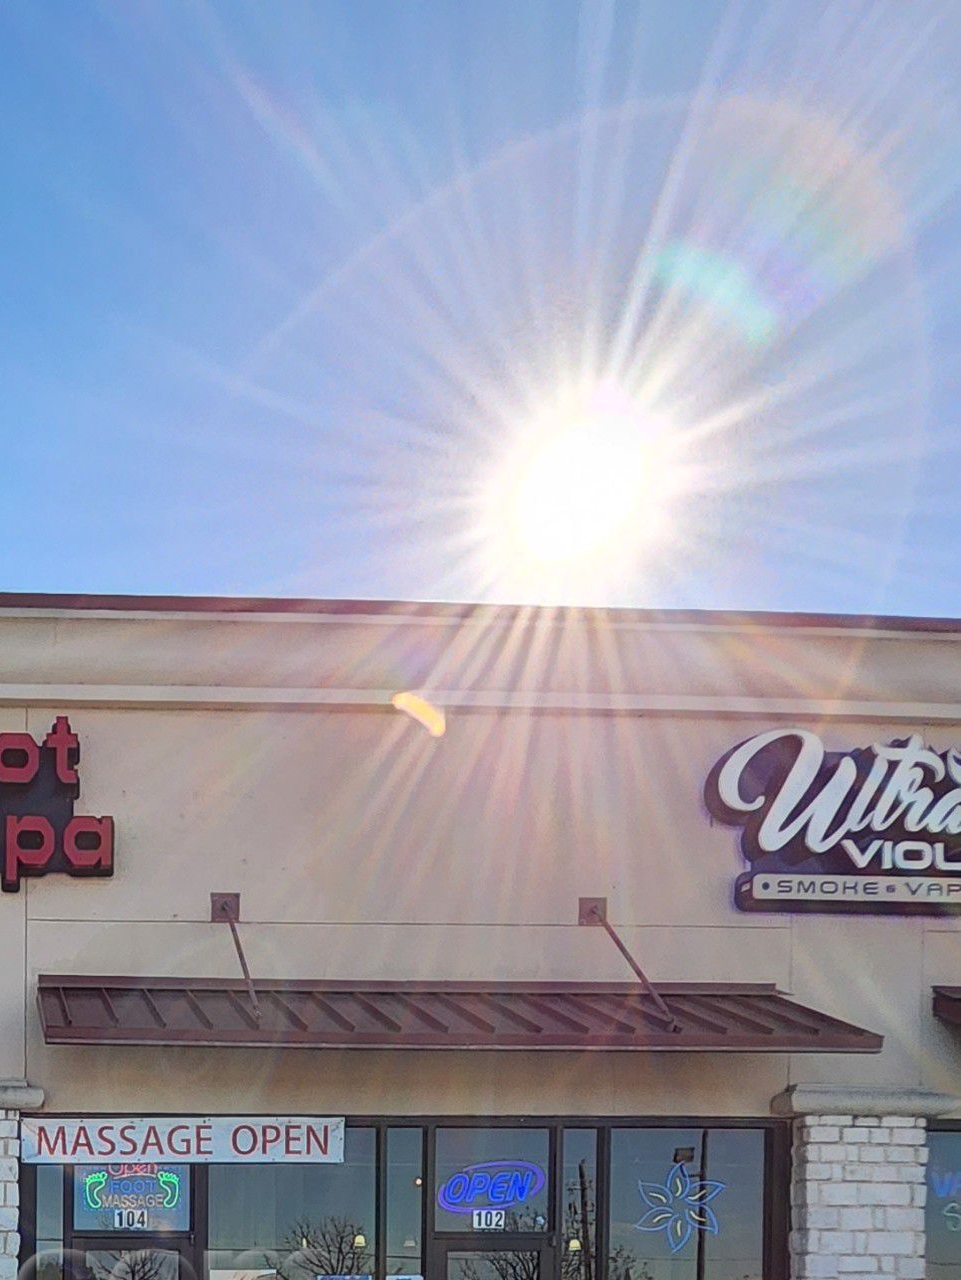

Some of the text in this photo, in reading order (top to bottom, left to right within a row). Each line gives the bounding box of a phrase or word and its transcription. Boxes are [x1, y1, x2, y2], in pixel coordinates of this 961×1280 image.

[777, 880, 879, 895] SMOKE
[37, 1124, 329, 1156] MASSAGE OPEN
[110, 1180, 156, 1194] FOOT
[445, 1171, 533, 1203] OPEN
[101, 1194, 164, 1208] MASSAGE
[116, 1210, 146, 1228] 104
[475, 1211, 503, 1228] 102
